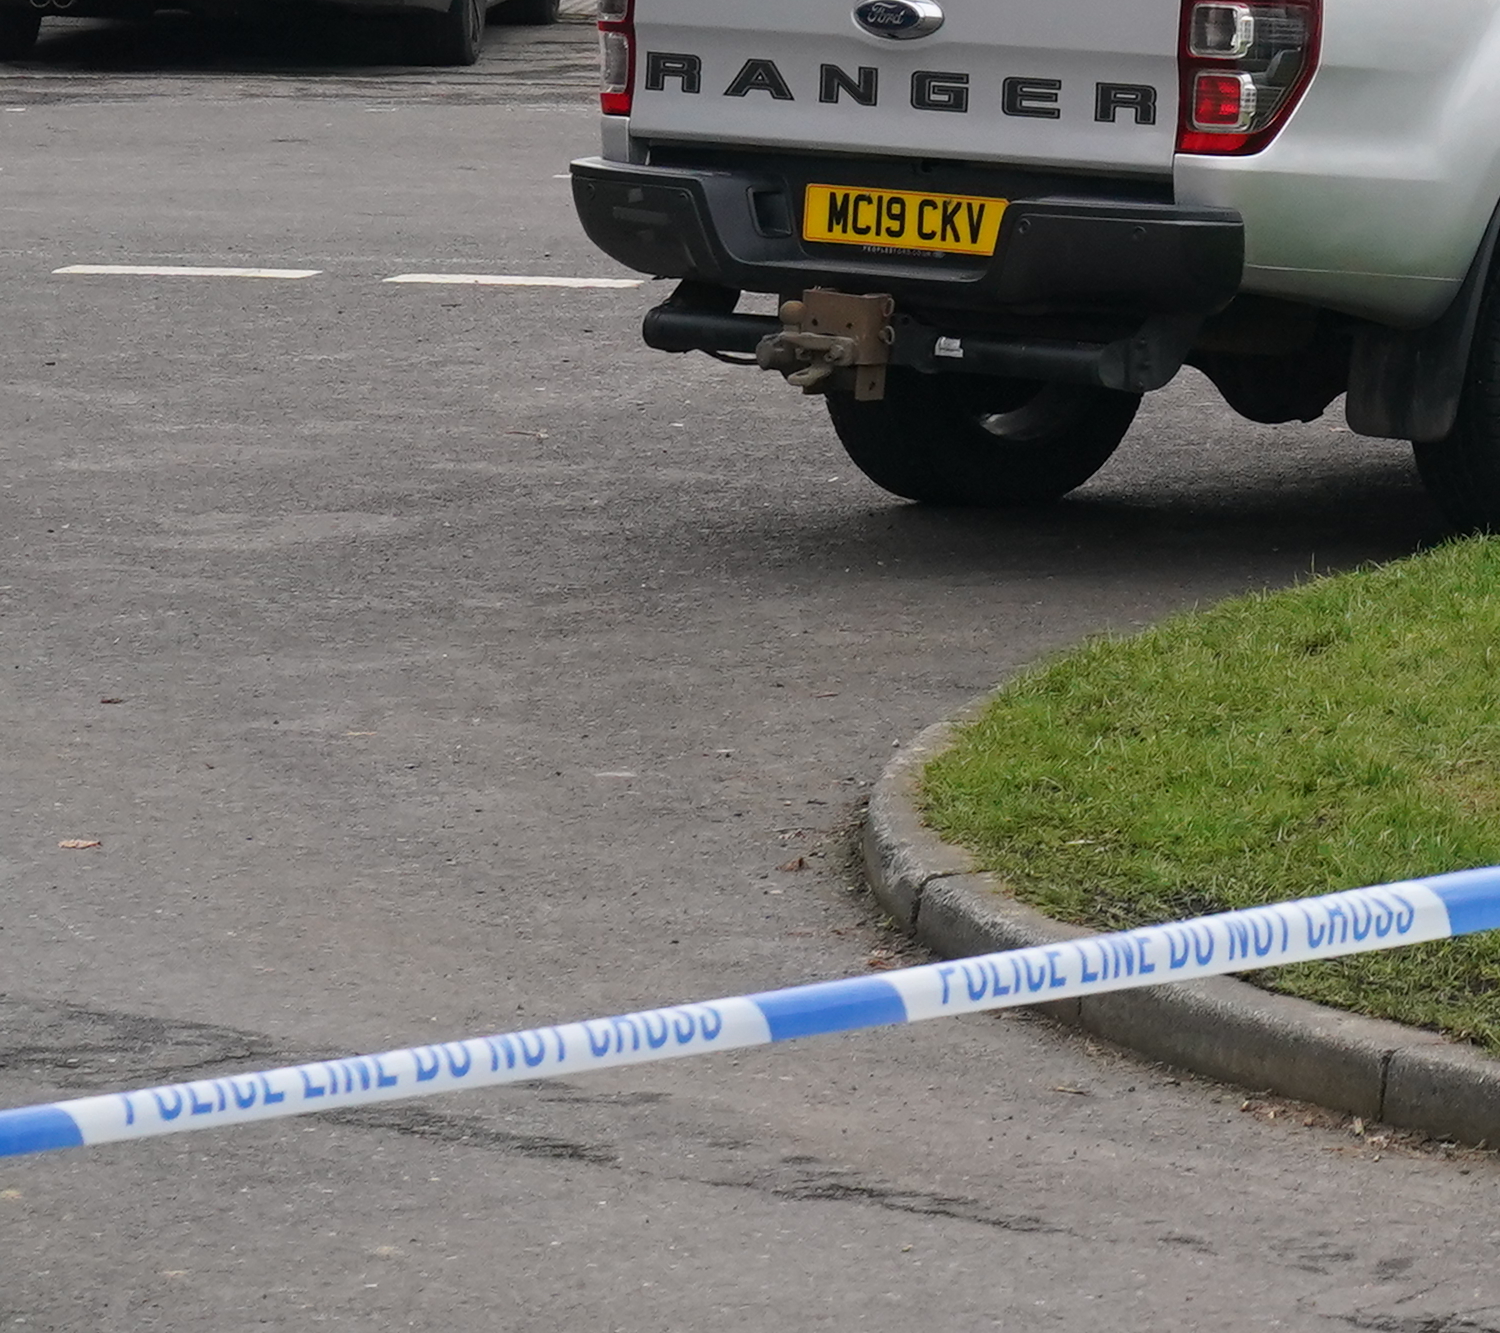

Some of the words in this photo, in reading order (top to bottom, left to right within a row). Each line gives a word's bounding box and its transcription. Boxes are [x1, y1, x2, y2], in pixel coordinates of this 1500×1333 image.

[866, 0, 907, 27] Ford
[645, 50, 1157, 126] RANGER
[827, 191, 907, 239] MC19
[917, 198, 986, 245] CKV
[936, 948, 1069, 1006] POLICE
[1074, 933, 1157, 984] LINE
[1163, 923, 1217, 970] DO
[1223, 910, 1294, 961] NOT
[1301, 888, 1419, 949] CROSS
